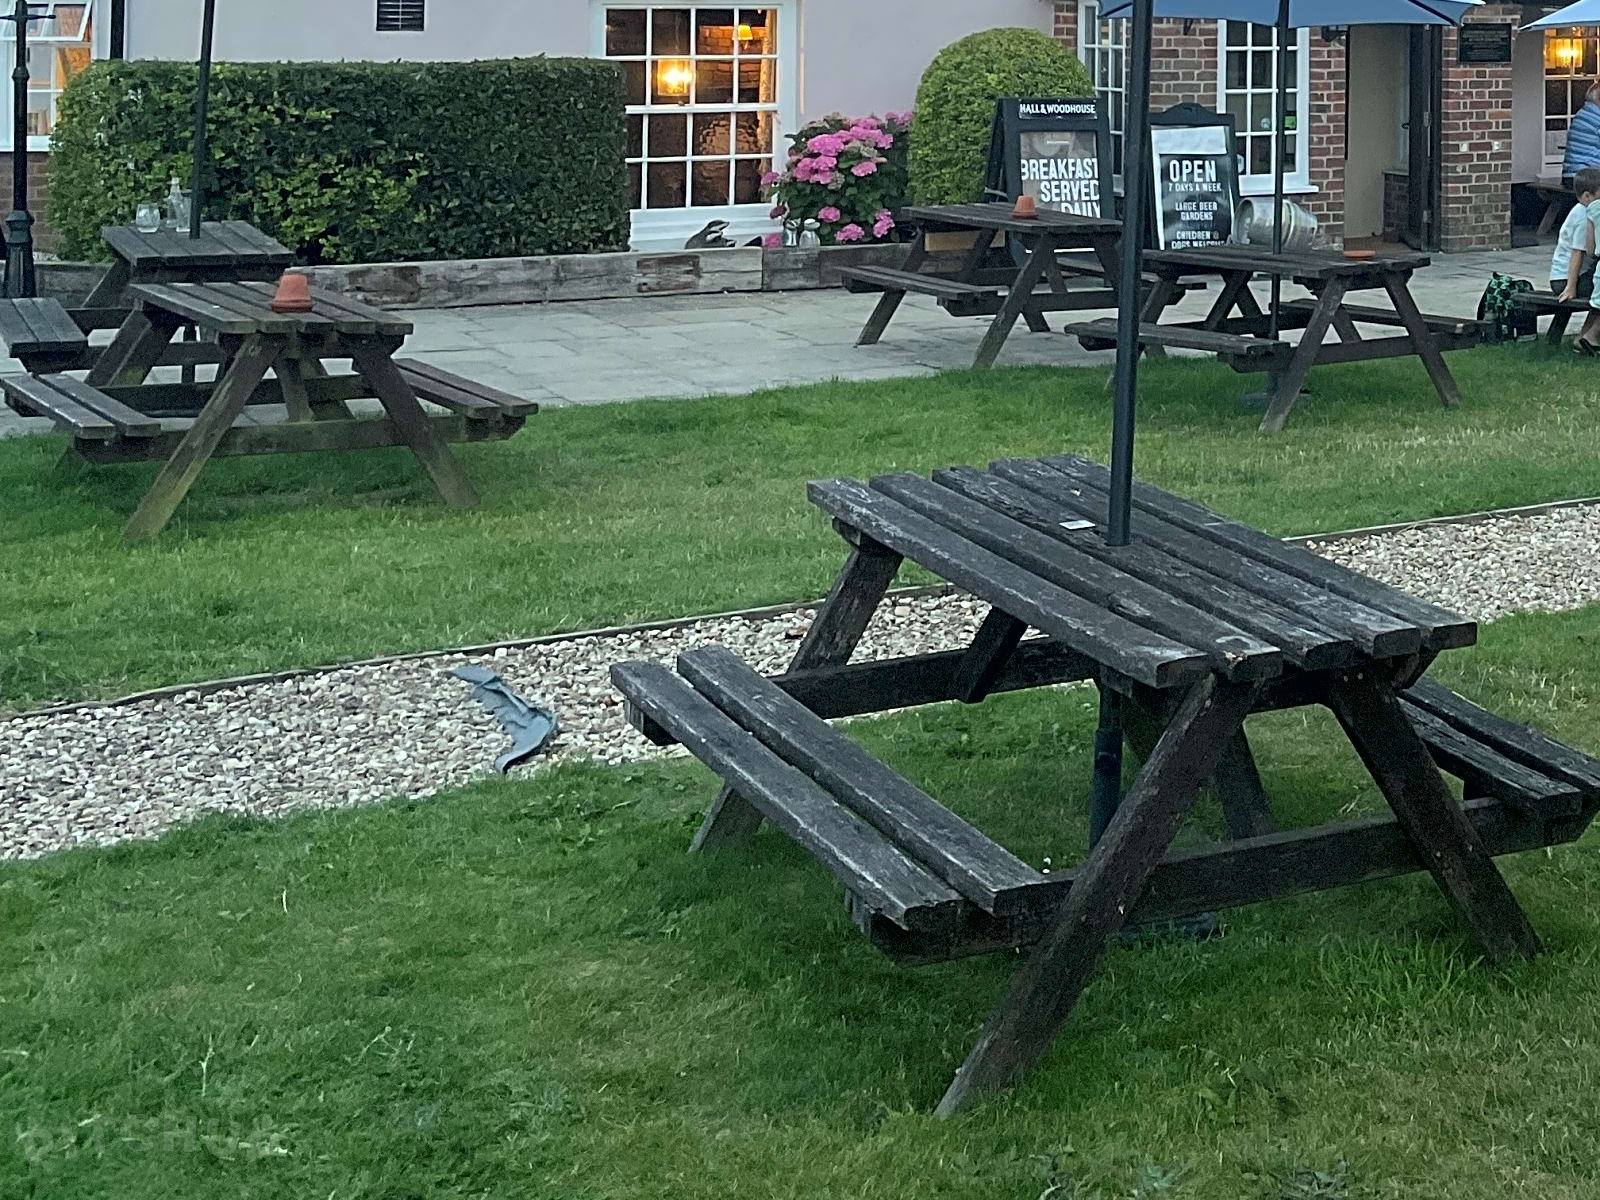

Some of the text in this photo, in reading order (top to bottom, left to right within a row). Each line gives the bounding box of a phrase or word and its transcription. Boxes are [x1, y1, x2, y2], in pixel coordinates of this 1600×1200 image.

[1021, 158, 1099, 181] BREAKFAST
[1169, 159, 1217, 183] OPEN
[1040, 179, 1100, 202] SERVED
[1168, 183, 1222, 192] 7 DAYS A WEEK
[1175, 201, 1218, 211] LARGE BEER
[1180, 211, 1213, 221] GARDENS
[1176, 230, 1211, 240] CHILDREN
